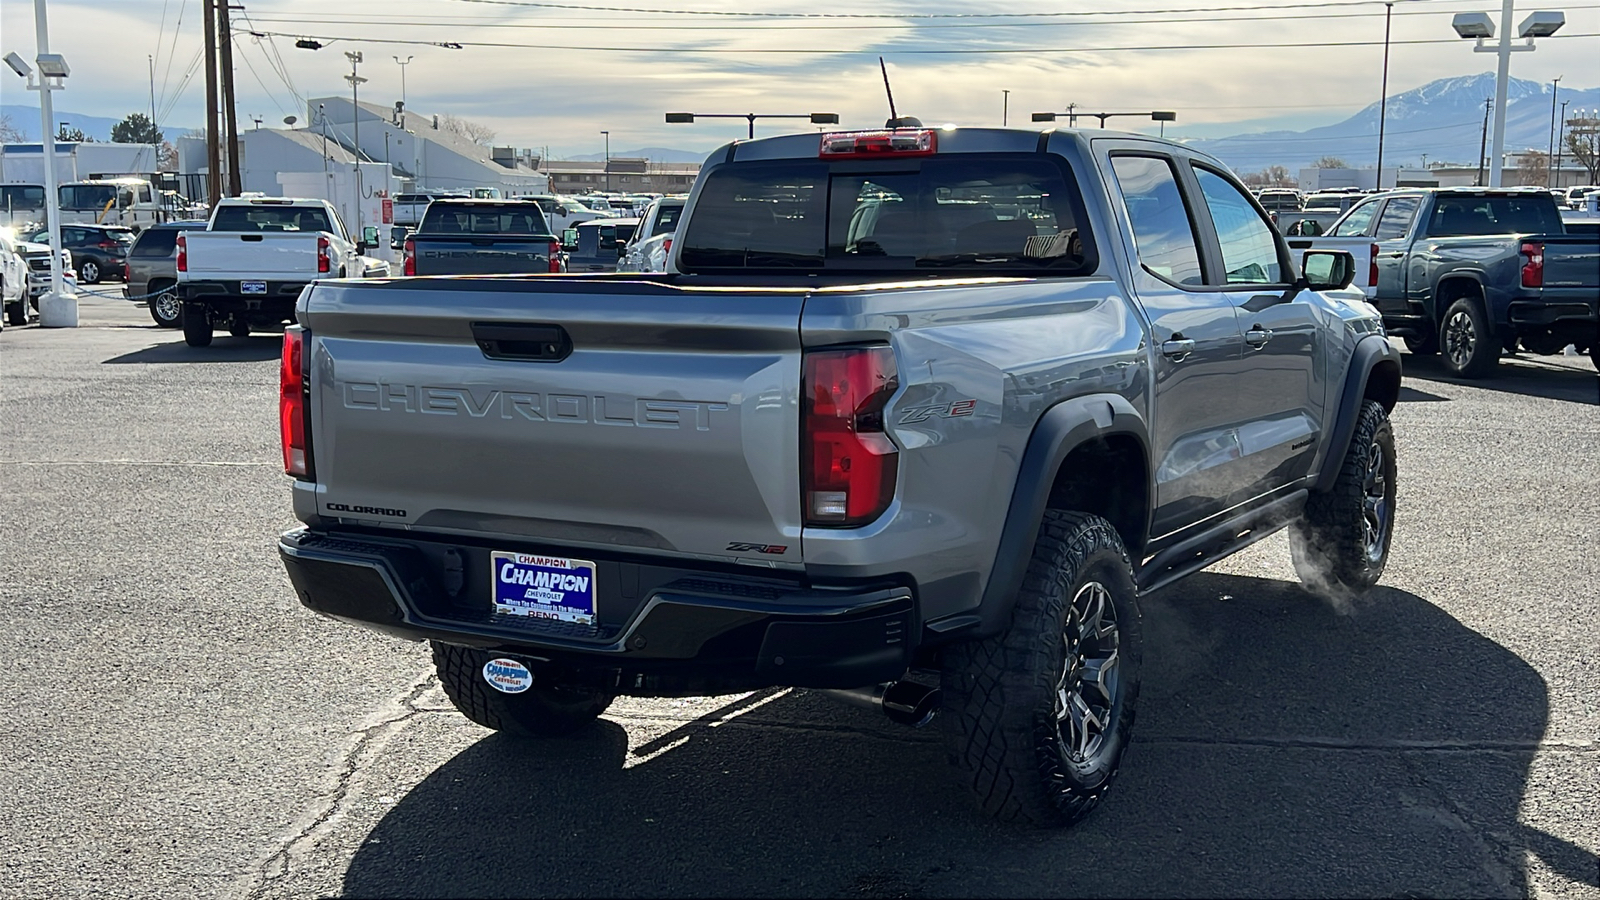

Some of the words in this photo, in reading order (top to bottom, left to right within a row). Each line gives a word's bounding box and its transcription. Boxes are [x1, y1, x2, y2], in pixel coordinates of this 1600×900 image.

[424, 251, 540, 260] CHEVROLET
[343, 381, 729, 432] CHEVROLET
[898, 399, 977, 425] ZR2
[326, 503, 407, 517] COLORADO
[725, 541, 788, 554] ZR2
[519, 555, 567, 567] CHAMPION
[500, 563, 589, 593] CHAMPION
[527, 590, 562, 600] CHEVROLET
[528, 610, 559, 620] RENO
[494, 676, 521, 686] CHEVROLET
